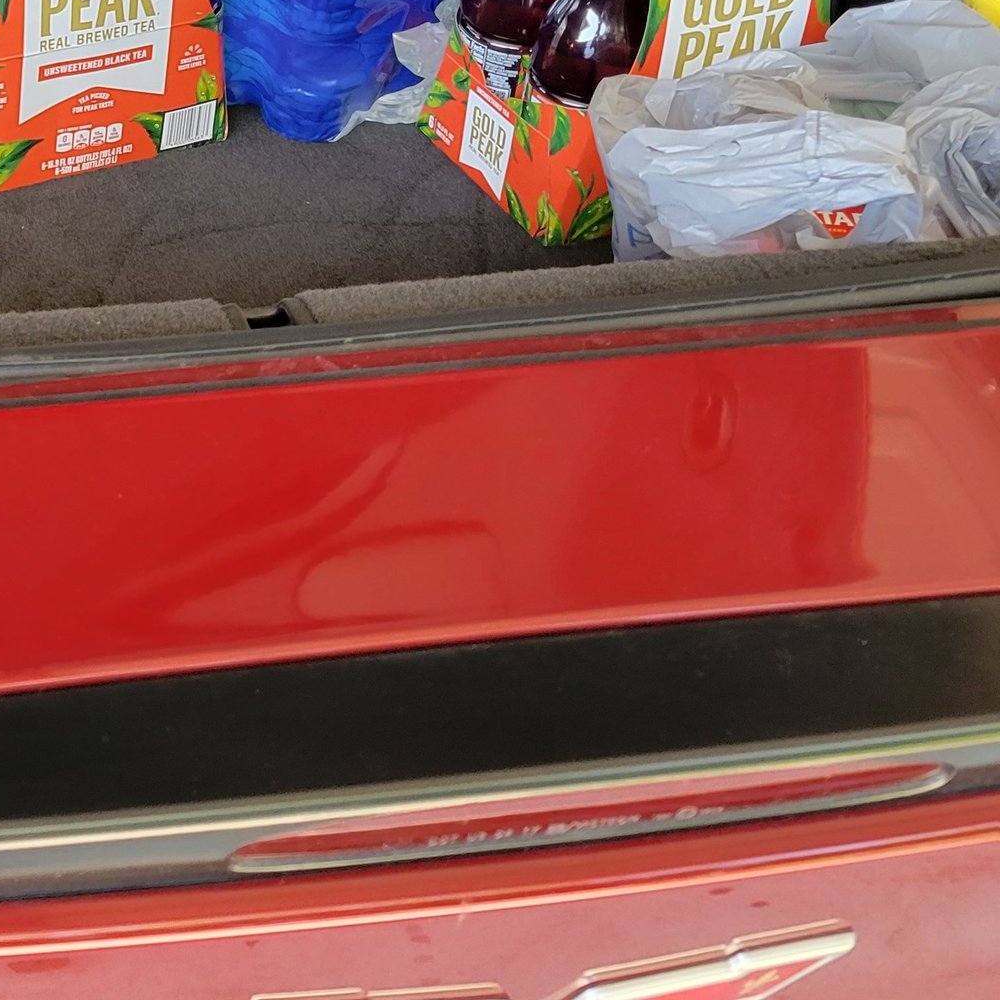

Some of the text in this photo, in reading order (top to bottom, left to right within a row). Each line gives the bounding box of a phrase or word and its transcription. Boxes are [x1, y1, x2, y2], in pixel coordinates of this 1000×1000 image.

[40, 19, 156, 52] REAL BREWED TEA
[673, 10, 794, 80] PEAK
[43, 49, 147, 77] UNSWEETENED BLACK TEA
[470, 125, 503, 172] PEAK
[472, 105, 507, 150] GOLD
